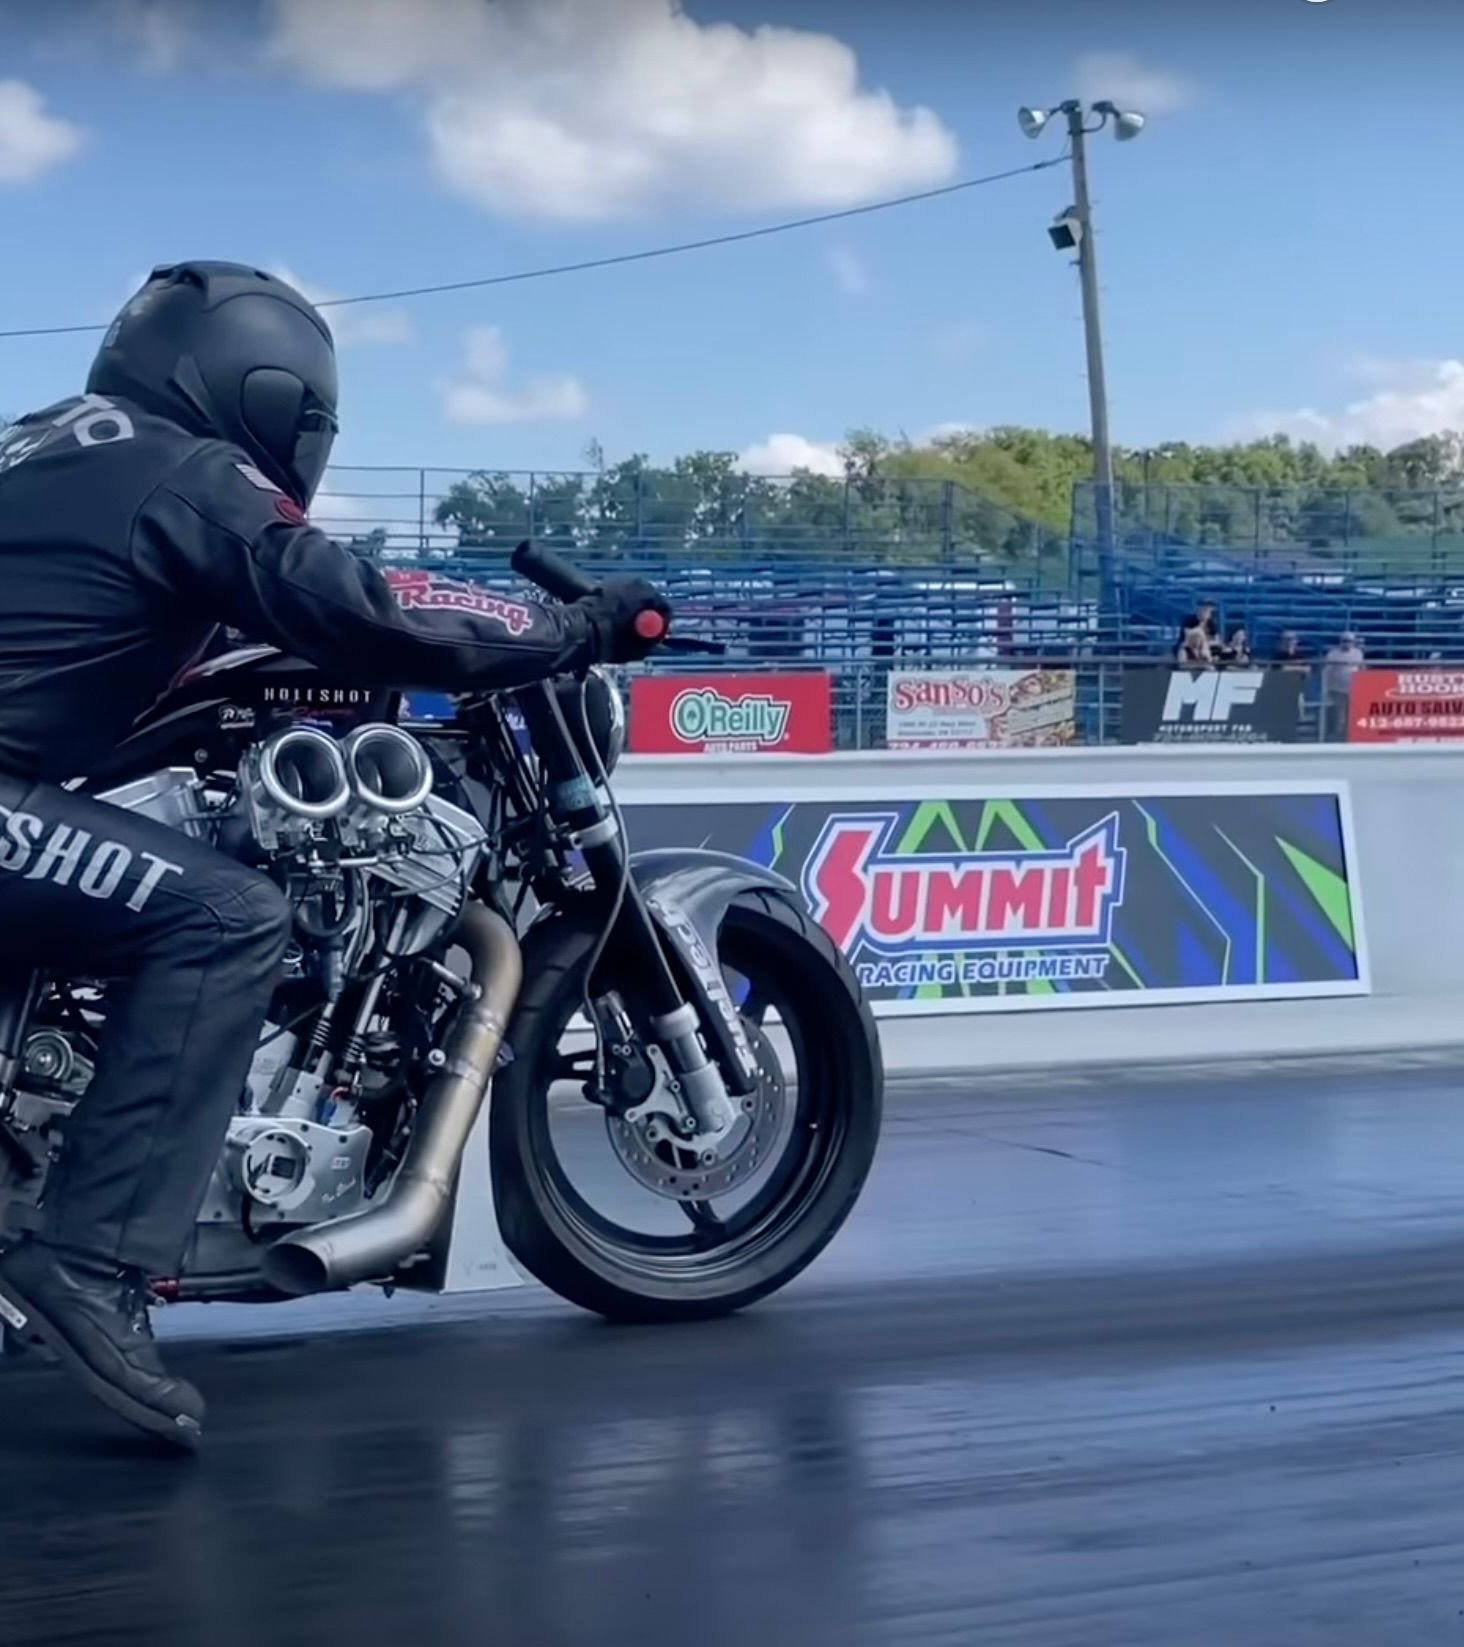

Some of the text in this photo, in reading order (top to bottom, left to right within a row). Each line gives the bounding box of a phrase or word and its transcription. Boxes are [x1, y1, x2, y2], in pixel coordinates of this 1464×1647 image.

[393, 586, 532, 635] Racing
[264, 687, 371, 703] HOLESHOT
[1162, 671, 1264, 721] MF
[1369, 701, 1464, 715] AUTO SALV
[674, 692, 786, 738] O'Reilly
[858, 955, 1109, 988] RACING EQUIPMENT
